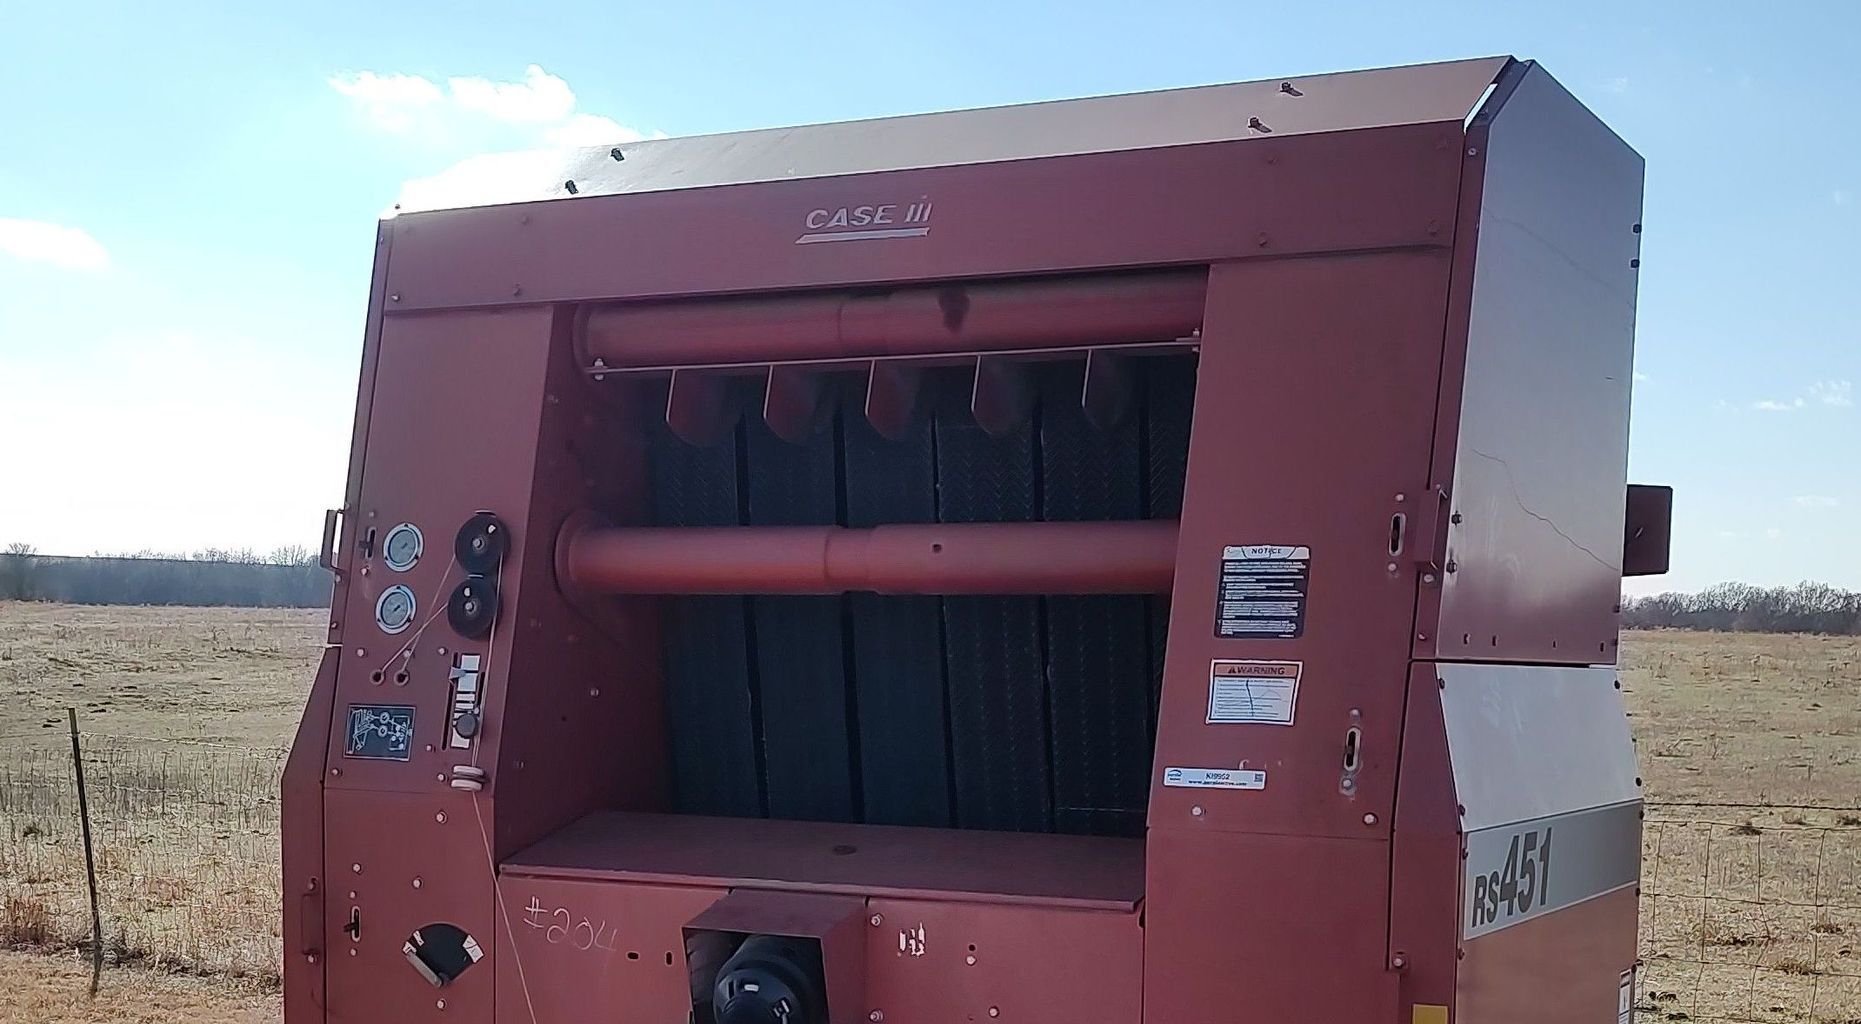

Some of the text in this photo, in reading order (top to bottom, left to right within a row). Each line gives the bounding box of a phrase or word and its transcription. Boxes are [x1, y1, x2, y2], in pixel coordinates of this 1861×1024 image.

[806, 205, 897, 229] CASE
[1238, 666, 1286, 675] WARNING
[1472, 827, 1551, 928] RS451
